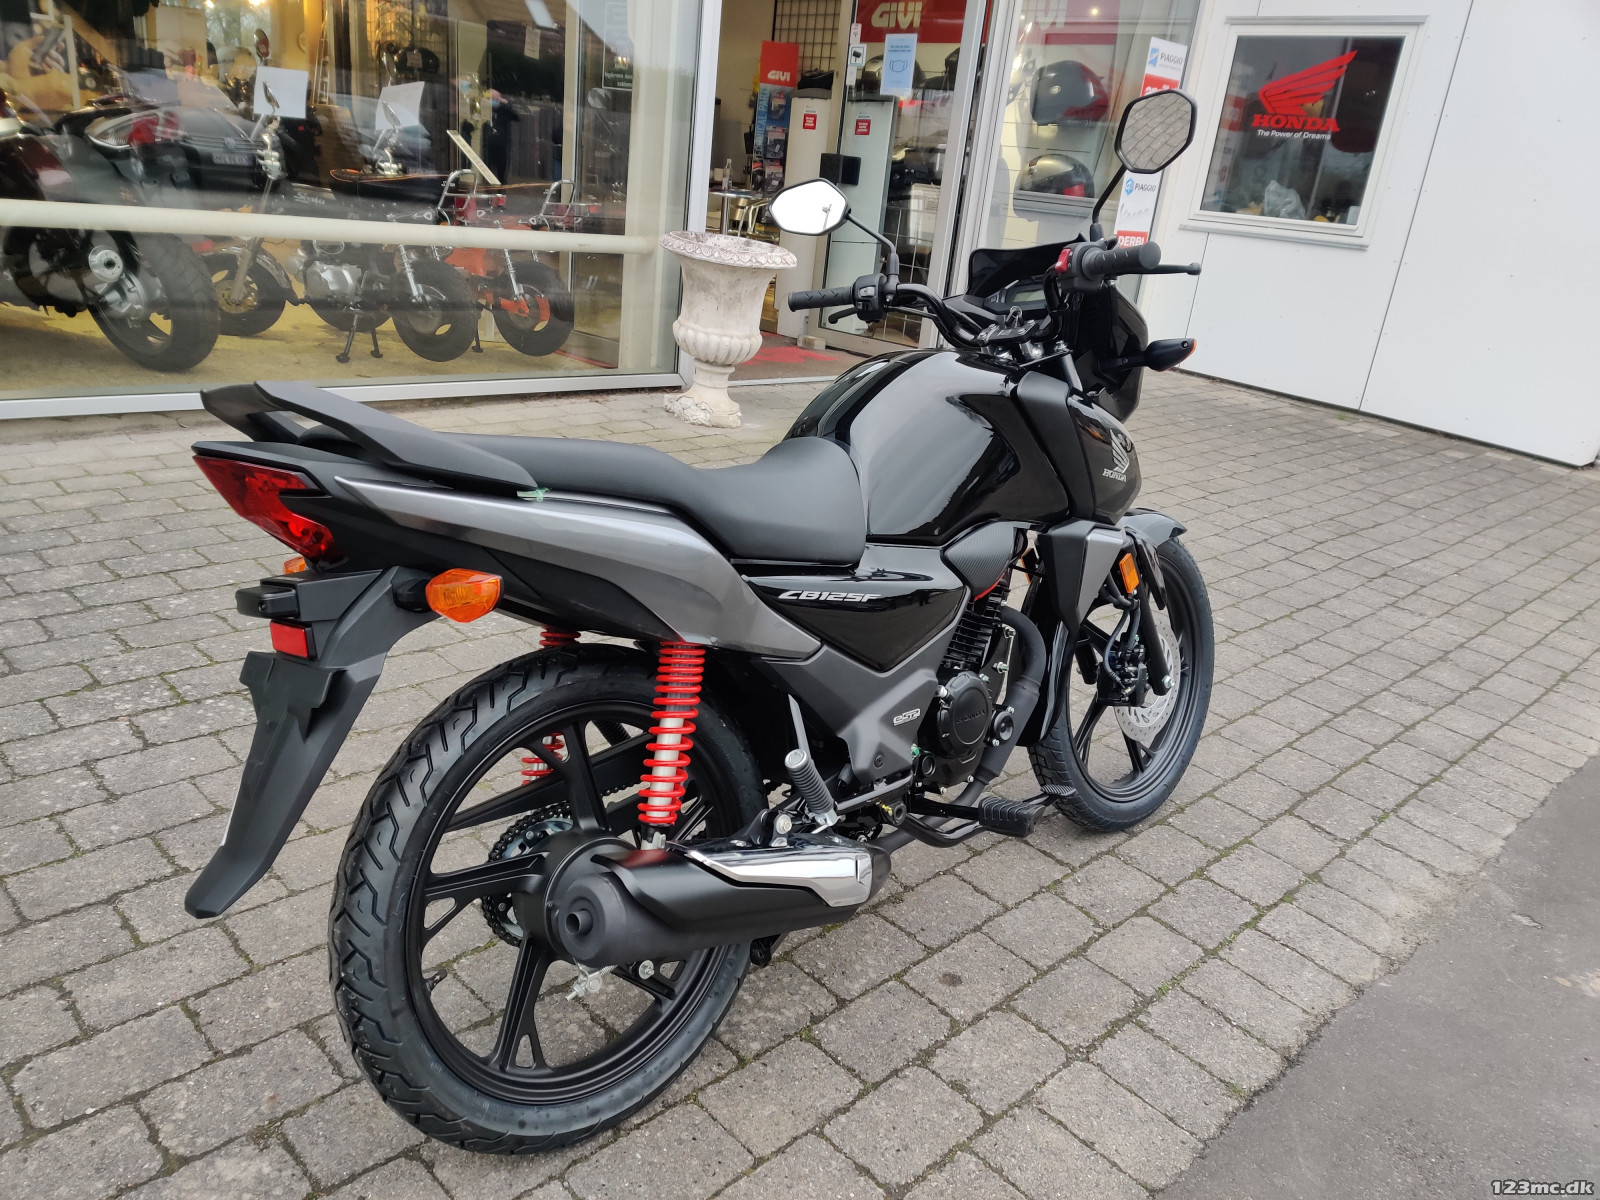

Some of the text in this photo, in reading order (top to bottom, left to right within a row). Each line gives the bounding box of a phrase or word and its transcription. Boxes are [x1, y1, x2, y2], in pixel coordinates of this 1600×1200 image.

[871, 1, 923, 30] GIVI
[1160, 52, 1184, 65] PIAGGIO
[767, 70, 790, 81] GIVI
[1252, 114, 1340, 131] HONDA
[1258, 129, 1269, 137] The
[1270, 130, 1293, 138] Power
[1303, 131, 1332, 140] Dreams
[1134, 183, 1157, 193] PIAGGIO
[1118, 235, 1145, 247] DERBI
[1102, 468, 1127, 483] HONDA
[778, 590, 882, 603] CB125F
